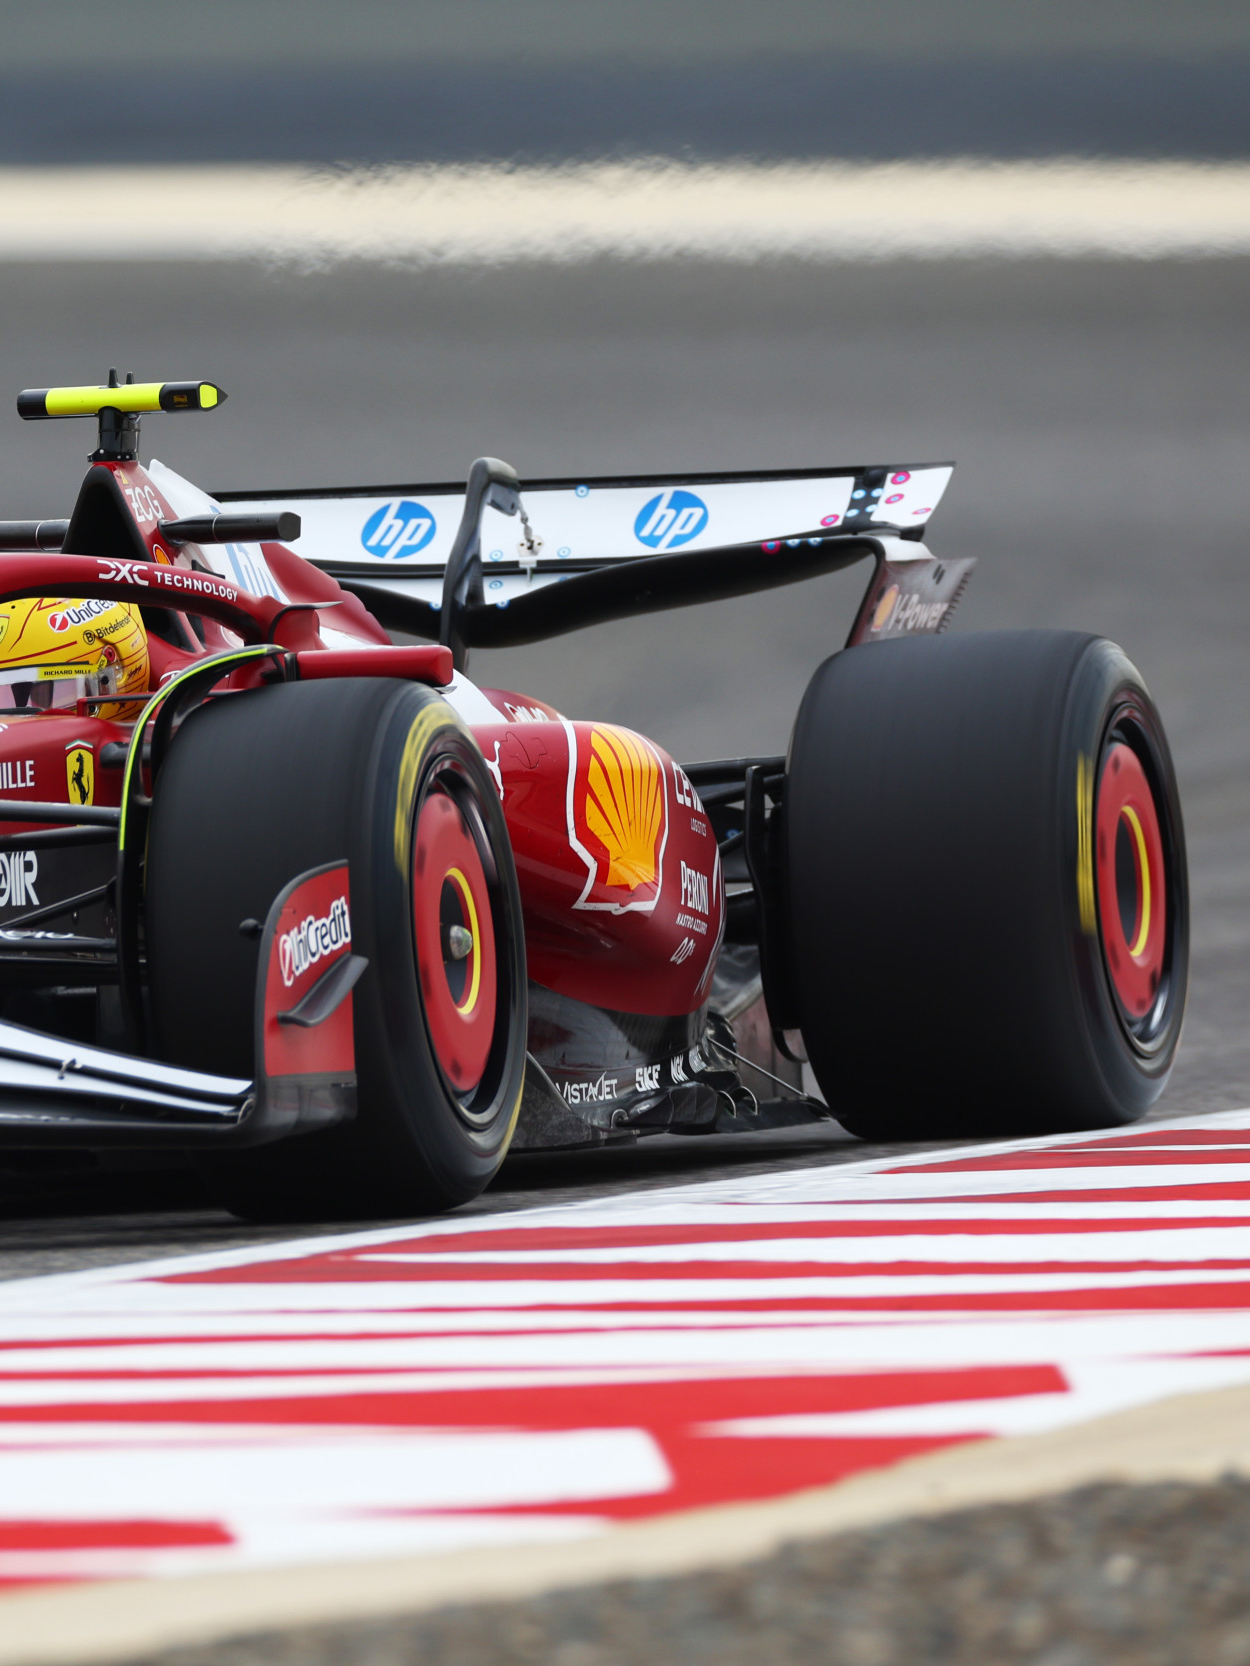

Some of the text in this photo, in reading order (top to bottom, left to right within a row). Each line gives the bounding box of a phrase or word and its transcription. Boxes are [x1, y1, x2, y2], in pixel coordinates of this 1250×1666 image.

[366, 500, 432, 560] hp
[639, 490, 704, 549] hp
[97, 560, 238, 602] DXC TECHNOLOGY
[888, 594, 949, 630] V-Power
[680, 860, 709, 915] PERONI
[291, 898, 350, 974] UniCredit
[636, 1064, 661, 1092] SKF
[671, 1054, 690, 1084] NGK
